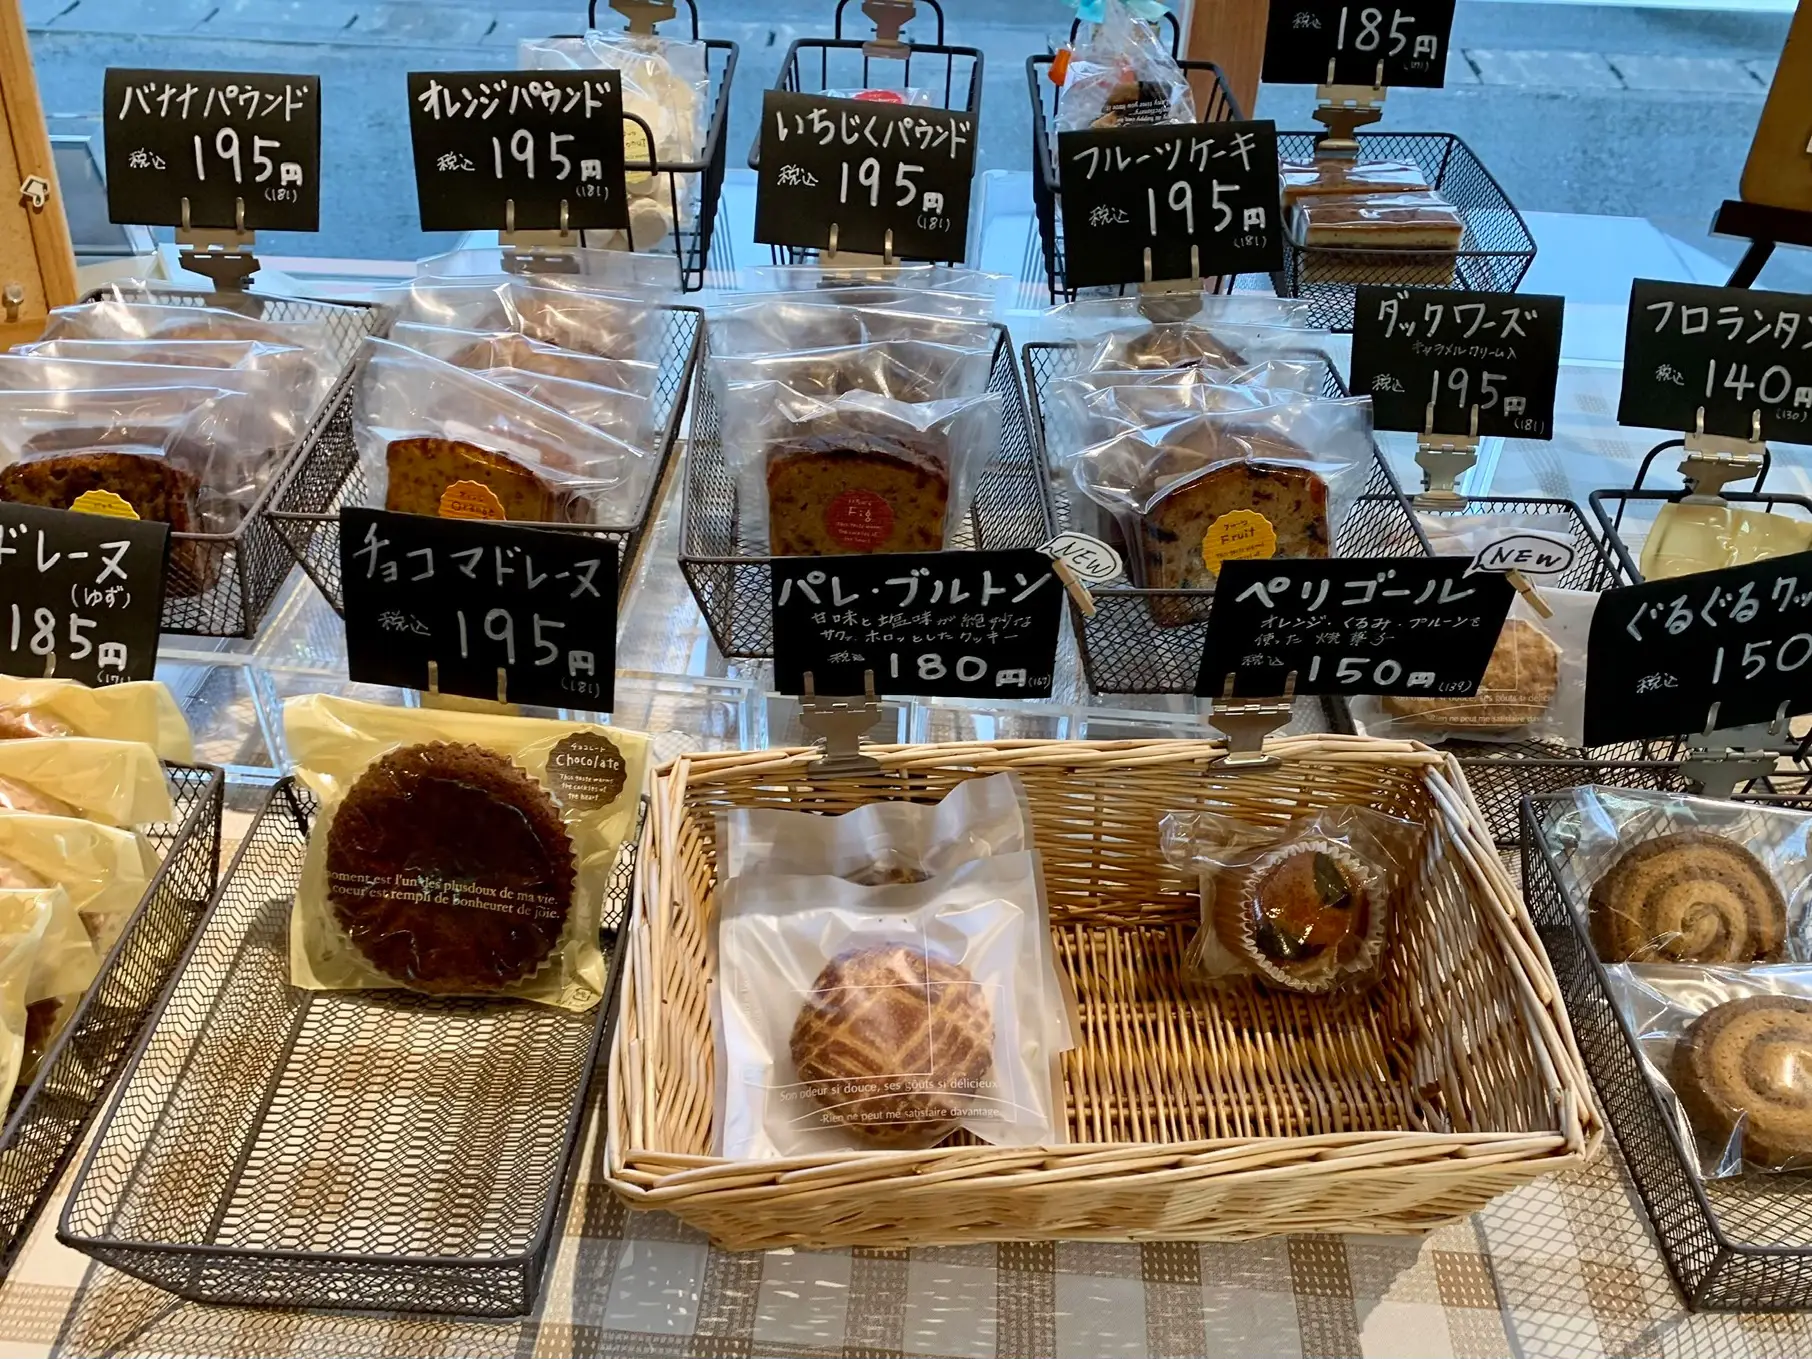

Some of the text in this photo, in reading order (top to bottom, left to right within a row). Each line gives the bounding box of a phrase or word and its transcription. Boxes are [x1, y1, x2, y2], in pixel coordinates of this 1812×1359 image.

[1337, 6, 1437, 60] 185円
[119, 83, 309, 121] バナナパウンド
[418, 79, 611, 120] オレンジパウンド
[776, 108, 971, 159] いちじくパウンド
[129, 127, 303, 187] 税込 195円
[437, 129, 602, 182] 税込 195円
[1072, 132, 1256, 180] フルーツケーキ
[777, 157, 944, 214] 税込 195円
[1089, 179, 1266, 236] 税込 195円
[1378, 290, 1538, 338] ダックワーズ
[1412, 341, 1517, 360] キャラメルクリーム入
[1371, 367, 1526, 417] 税込 195円
[1656, 359, 1812, 408] 税込 140円
[1220, 526, 1256, 545] Fruit
[353, 522, 601, 598] チョコマドレーヌ
[1054, 541, 1111, 574] NEW
[1490, 546, 1562, 568] NEW
[71, 583, 130, 609] (ゆず)
[779, 567, 1052, 607] パレ・ブルトン
[1236, 569, 1475, 612] ペリゴール
[10, 603, 127, 671] 185円
[379, 608, 594, 677] 税込 195円
[890, 653, 1026, 687] 180円
[1241, 653, 1284, 666] 税込
[1308, 655, 1435, 688] 150円
[1636, 632, 1812, 693] 税込 150
[556, 753, 620, 771] Chocolate
[391, 888, 431, 905] rempli
[434, 891, 449, 905] de
[499, 885, 515, 900] de
[517, 891, 535, 903] ma
[843, 1082, 881, 1095] douce,
[861, 1110, 884, 1122] peut
